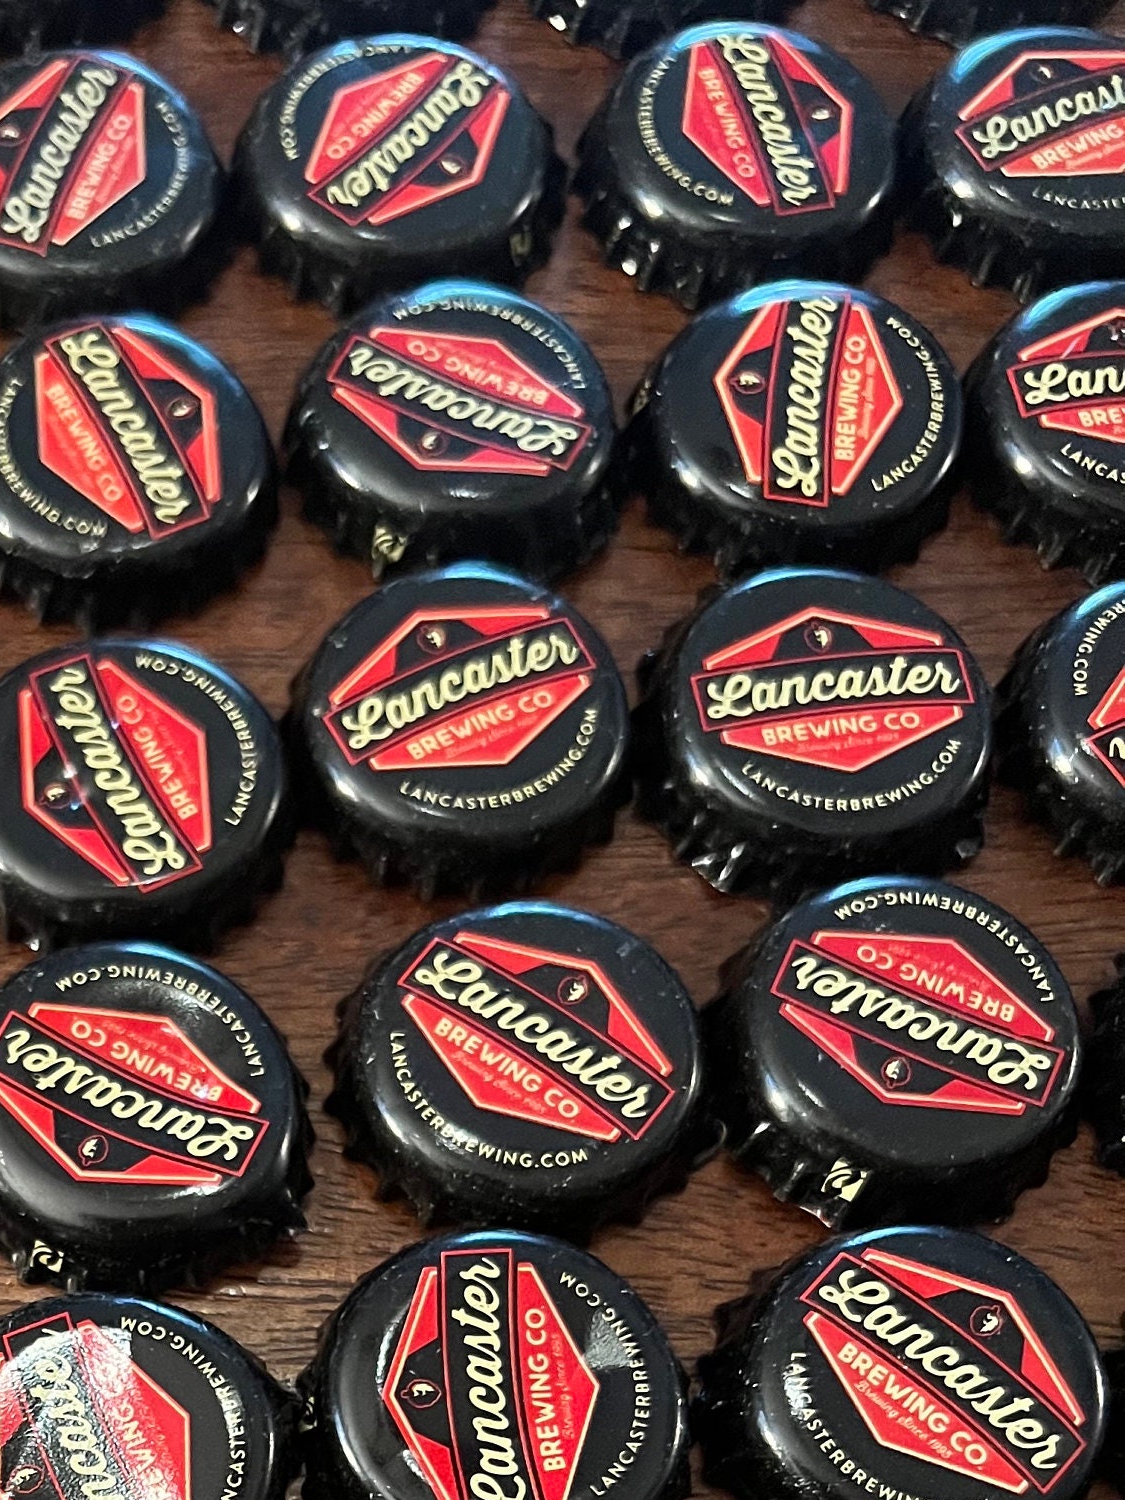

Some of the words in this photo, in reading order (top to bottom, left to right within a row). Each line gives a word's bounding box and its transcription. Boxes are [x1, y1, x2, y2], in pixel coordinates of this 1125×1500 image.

[6, 69, 116, 239] Lancaster
[328, 62, 488, 205] Lancaster
[716, 33, 816, 208] Lancaster
[59, 334, 186, 522] Lancaster
[351, 351, 576, 456] Lancaster
[773, 295, 837, 496] Lancaster
[836, 369, 861, 461] BREWING
[872, 315, 945, 490] LANCASTERBREWING.COM
[343, 634, 578, 747] Lancaster
[407, 705, 513, 759] BREWING
[707, 658, 961, 719] Lancaster
[761, 716, 876, 744] BREWING
[51, 669, 187, 877] Lancaster
[134, 726, 199, 819] BREWING
[400, 708, 597, 809] LANCASTERBREWING.COM
[741, 739, 961, 810] LANCASTERBREWING.COM
[837, 892, 1055, 1000] LANCASTERBREWING.COM
[899, 964, 1015, 1023] BREWING
[55, 965, 265, 1080] LANCASTERBREWING.COM
[111, 1040, 223, 1102] BREWING
[414, 952, 645, 1116] Lancaster
[434, 1017, 541, 1091] BREWING
[796, 956, 1053, 1089] Lancaster
[5, 1029, 253, 1169] Lancaster
[390, 1032, 586, 1167] LANCASTERBREWING.COM
[529, 1351, 565, 1471] BREWING
[561, 1273, 650, 1498] LANCASTERBREWING.COM
[820, 1269, 1060, 1468] Lancaster
[838, 1340, 949, 1430] BREWING
